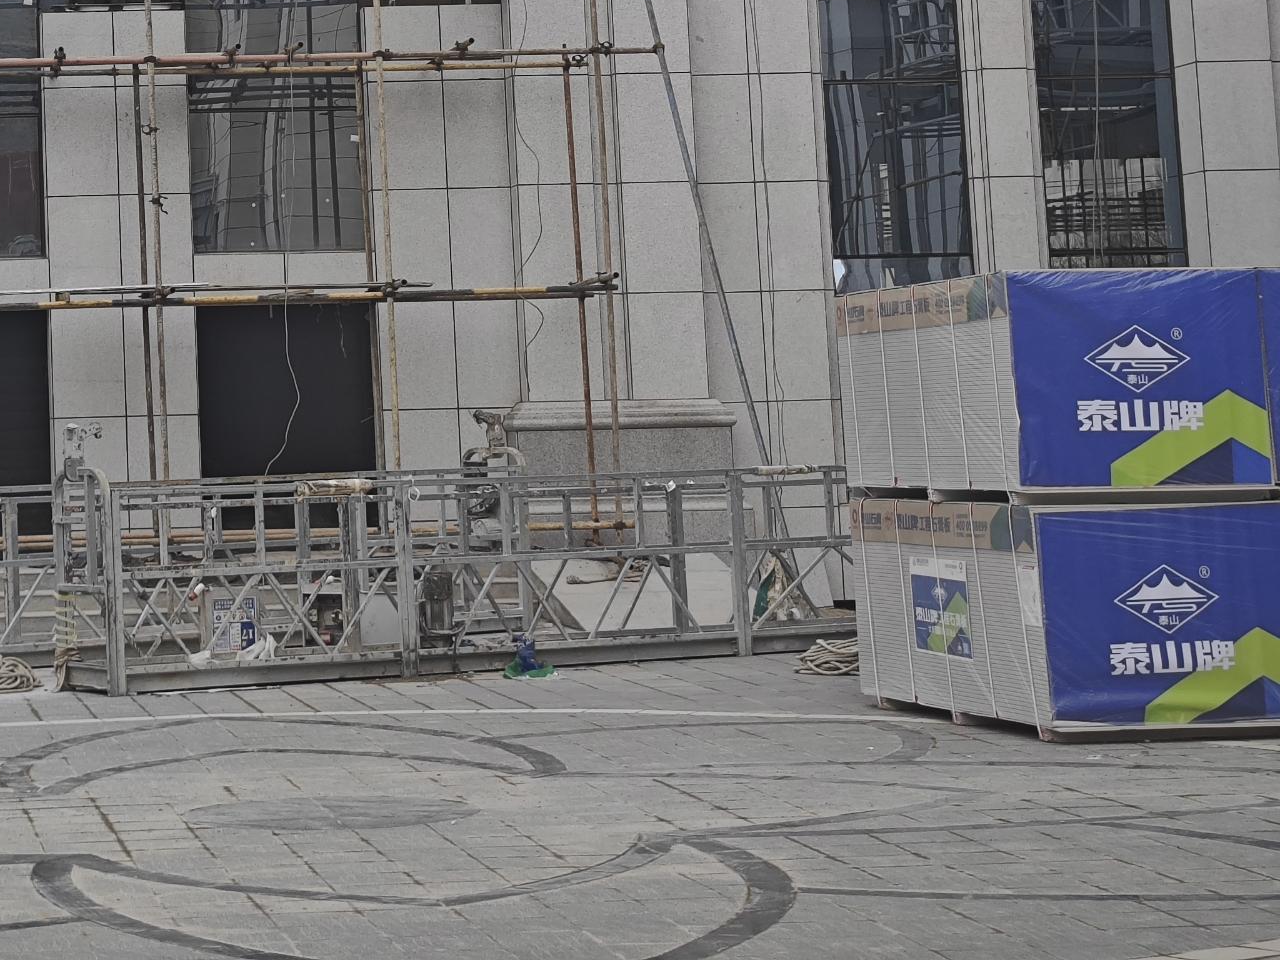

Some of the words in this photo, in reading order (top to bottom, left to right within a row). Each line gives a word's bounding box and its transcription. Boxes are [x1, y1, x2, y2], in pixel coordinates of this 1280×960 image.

[1127, 374, 1148, 384] 泰山
[1077, 399, 1204, 431] 泰山牌
[1159, 615, 1180, 625] 泰山
[1110, 640, 1236, 676] 泰山牌
